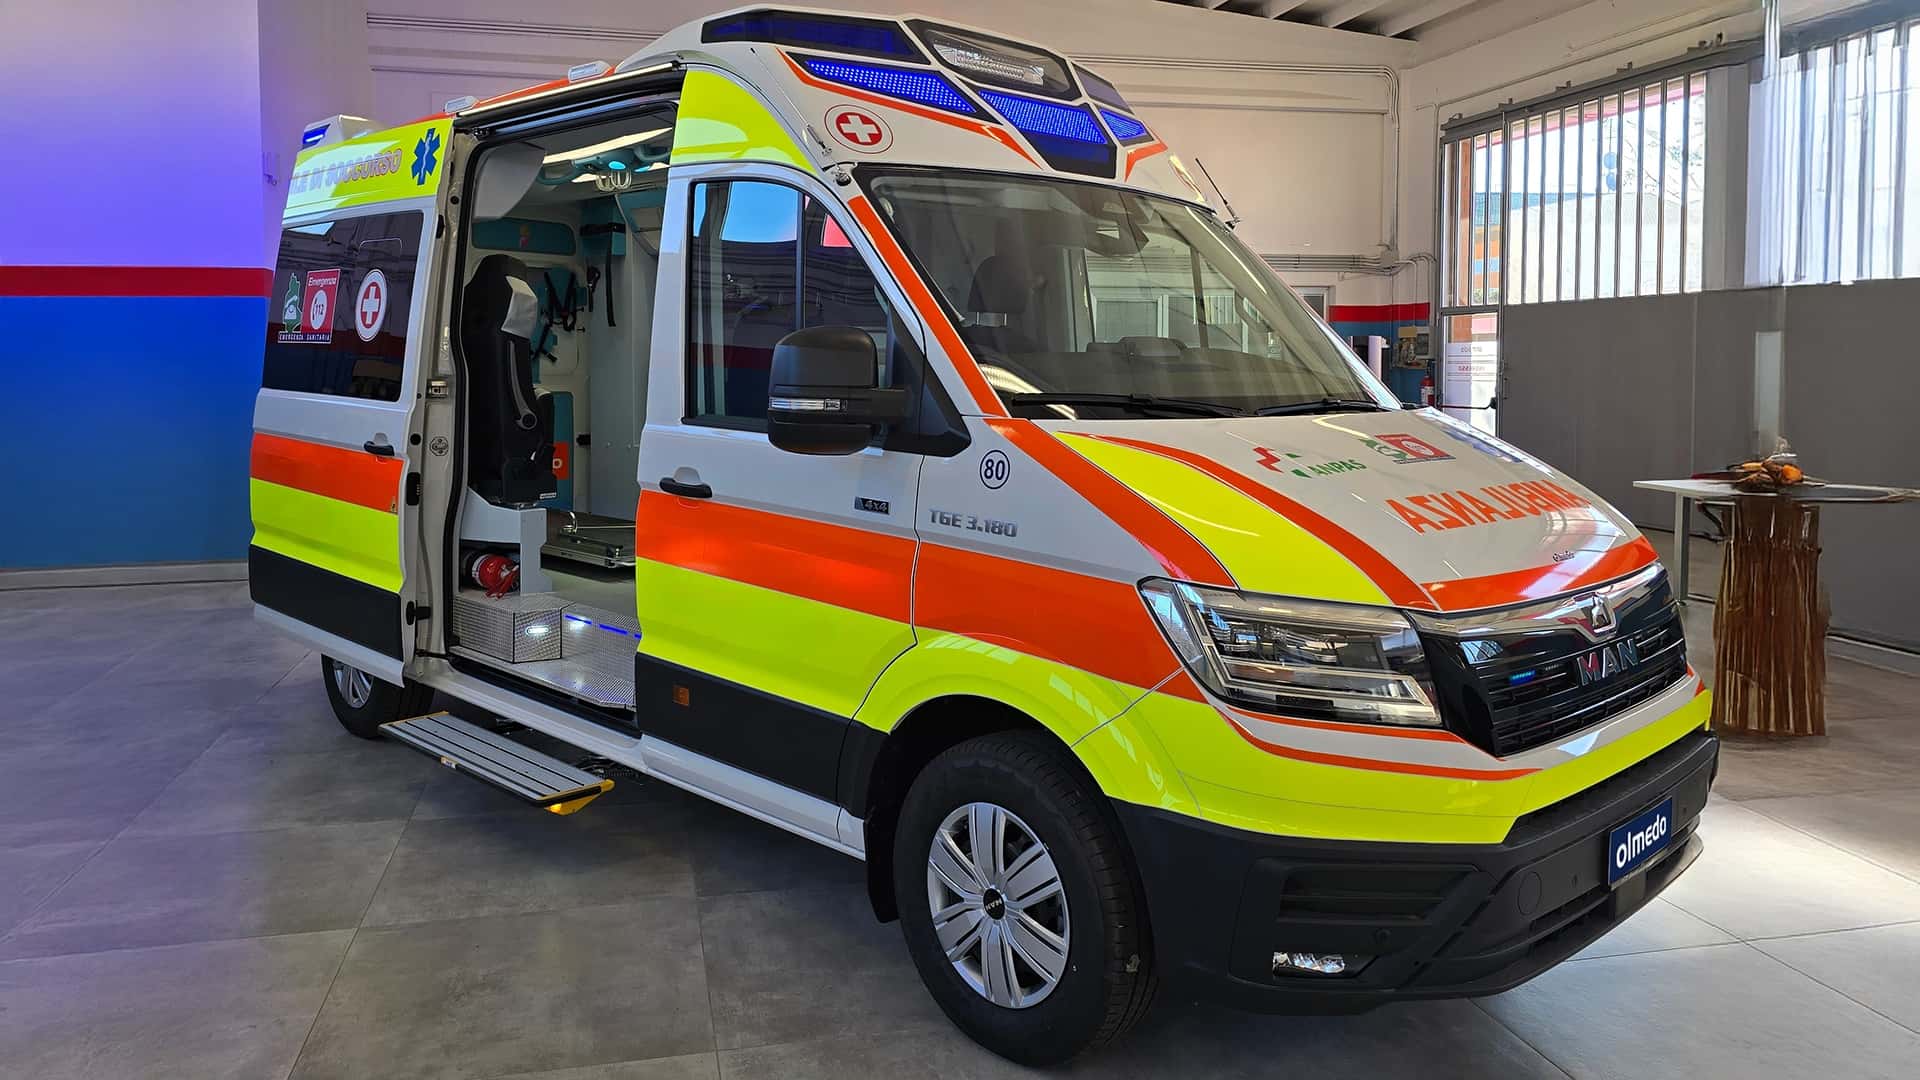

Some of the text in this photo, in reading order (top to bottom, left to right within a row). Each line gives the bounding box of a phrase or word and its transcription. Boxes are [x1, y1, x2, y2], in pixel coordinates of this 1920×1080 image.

[326, 148, 402, 185] SOCCORSO
[983, 458, 1006, 481] 80
[1307, 459, 1367, 476] ANPAS
[864, 499, 888, 513] 4x4
[929, 508, 1018, 538] TGE 3.180
[1577, 638, 1638, 687] MAN
[1615, 813, 1667, 869] olmedo
